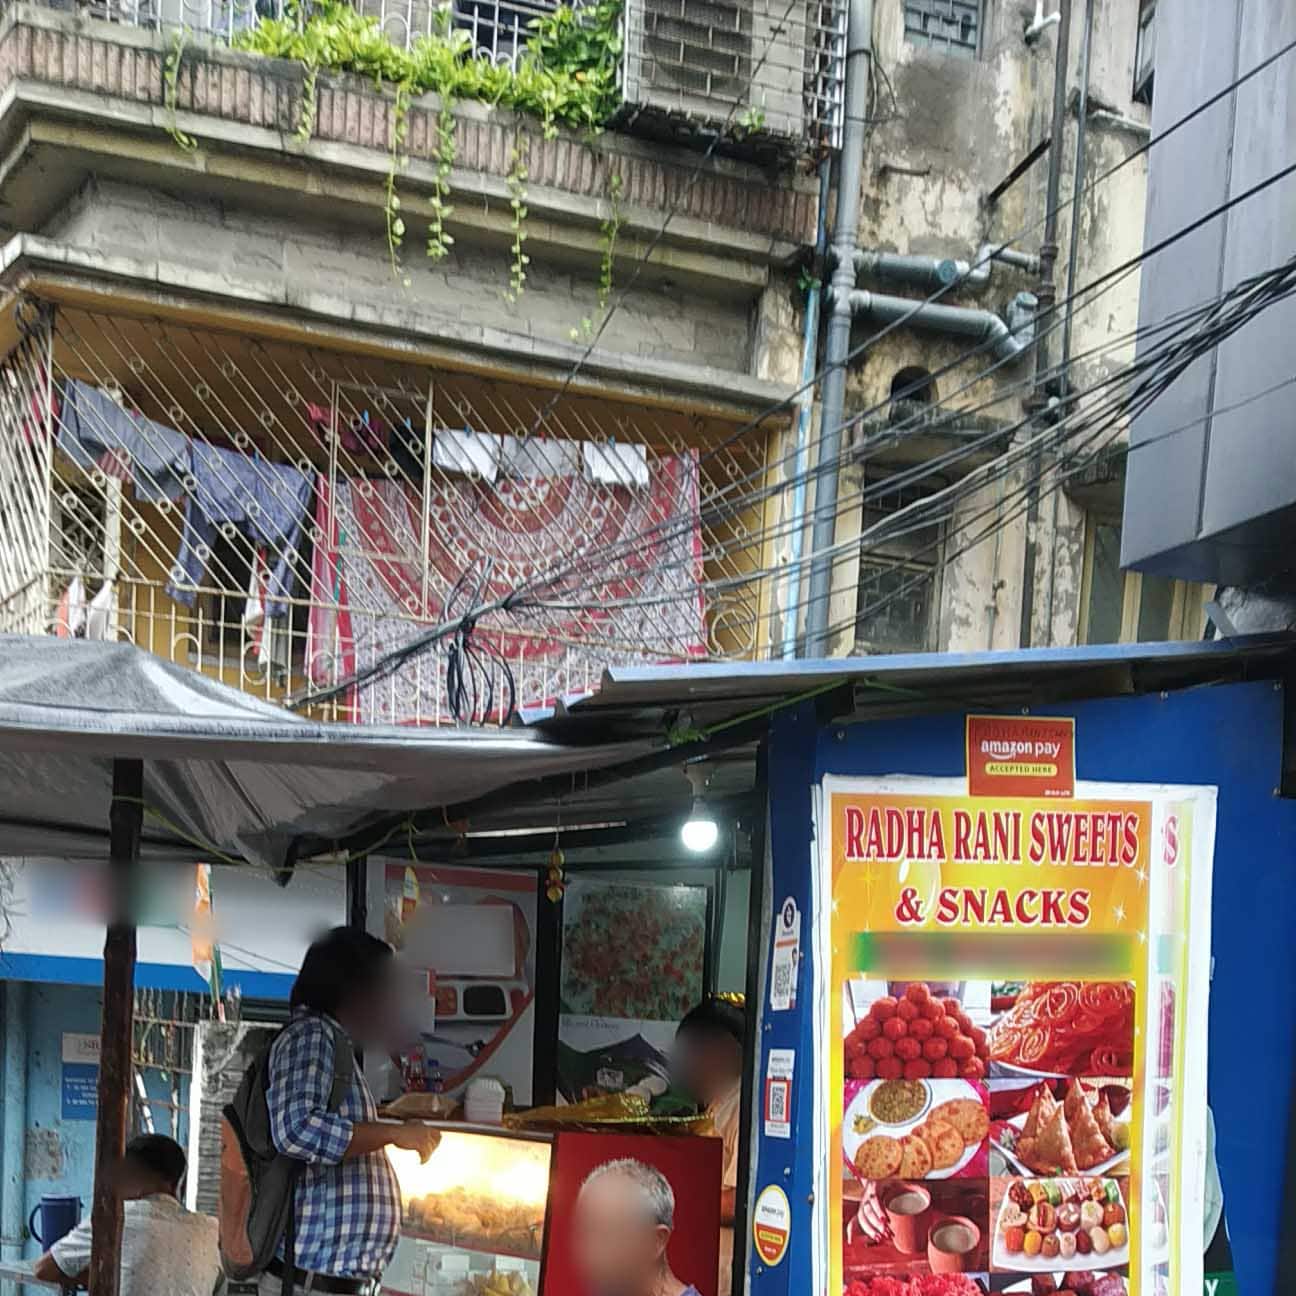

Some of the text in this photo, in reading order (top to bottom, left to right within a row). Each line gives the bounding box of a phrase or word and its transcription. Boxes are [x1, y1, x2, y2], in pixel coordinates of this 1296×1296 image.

[981, 740, 1061, 759] amazon pay
[989, 764, 1053, 775] ACCEPTED HERE
[845, 807, 1140, 866] RADHA RANI SWEETS
[895, 887, 1091, 925] & SNACKS
